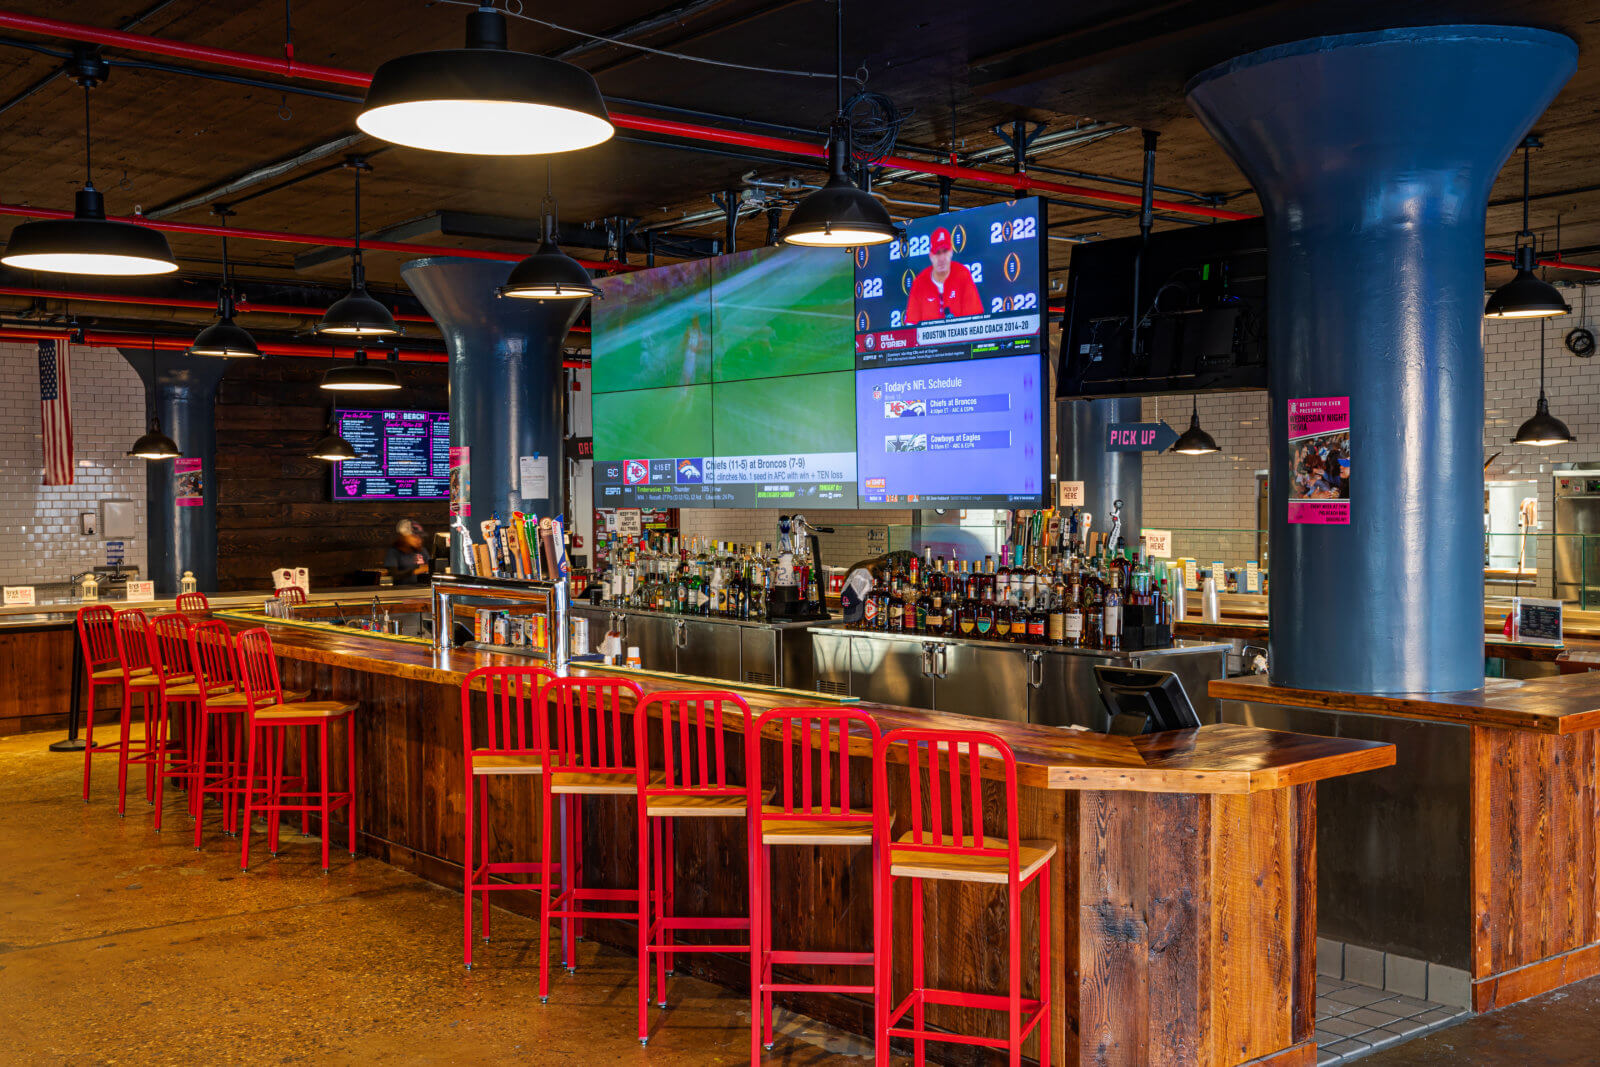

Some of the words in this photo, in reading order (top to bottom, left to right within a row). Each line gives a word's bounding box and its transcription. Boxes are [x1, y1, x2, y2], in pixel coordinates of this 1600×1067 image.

[922, 330, 946, 340] HOUSTON
[948, 327, 968, 336] TEXANS
[969, 325, 984, 335] HEAD
[984, 323, 1003, 334] COACH
[880, 339, 906, 348] O'BRIEN
[884, 381, 912, 394] Today's
[912, 380, 926, 390] NFL
[928, 377, 962, 389] Schedule
[930, 400, 946, 408] Chiefs
[954, 398, 977, 406] Broncos
[403, 412, 425, 420] BEACH
[1290, 414, 1326, 423] WEDNESDAY
[1326, 413, 1347, 422] NIGHT
[1290, 423, 1308, 432] TRIVIA
[930, 435, 954, 444] Cowboys
[962, 434, 981, 442] Eagles
[1110, 430, 1136, 445] PICK
[1141, 430, 1156, 445] UP
[706, 460, 727, 470] Chiefs
[728, 459, 748, 470] (11-5)
[749, 460, 756, 468] at
[758, 459, 787, 469] Broncos
[788, 457, 806, 469] (7-9)
[607, 468, 619, 477] SC
[716, 472, 738, 480] clinches
[753, 472, 767, 480] seed
[830, 470, 843, 478] loss
[605, 487, 621, 495] ESPN
[1150, 542, 1164, 550] HERE
